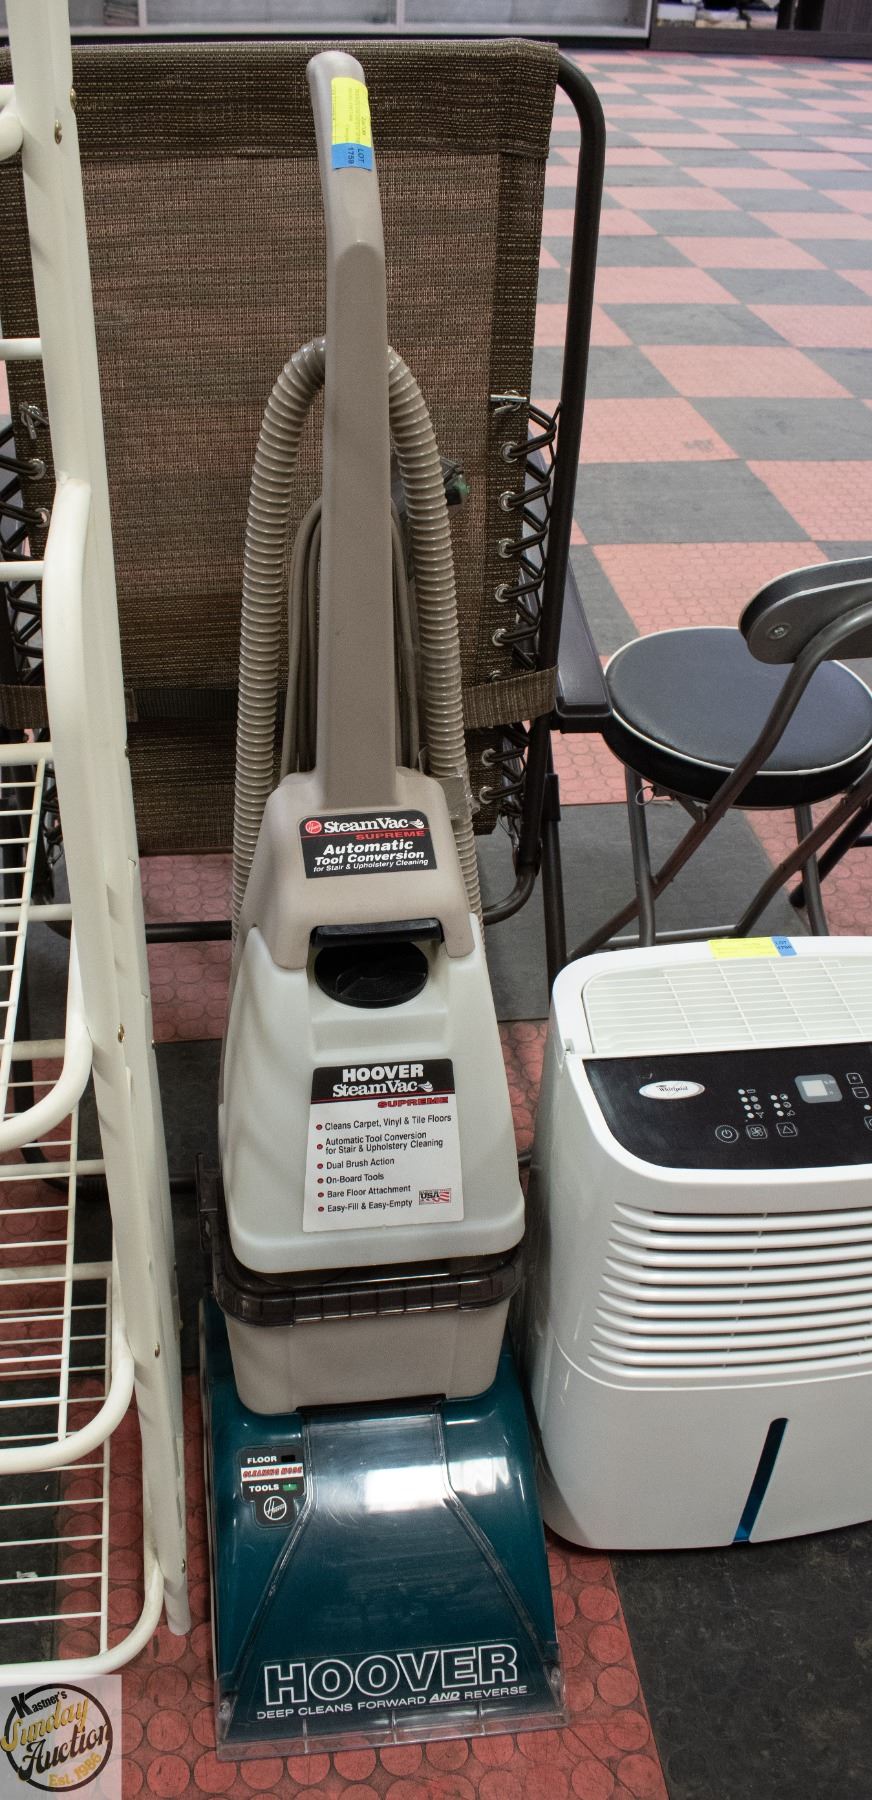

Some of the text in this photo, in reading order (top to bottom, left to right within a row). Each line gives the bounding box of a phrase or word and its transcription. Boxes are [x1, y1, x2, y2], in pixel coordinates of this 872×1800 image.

[357, 148, 366, 163] LOT
[324, 818, 408, 833] SteamVac
[355, 830, 425, 840] SUPREME
[322, 839, 414, 855] Automatic
[314, 850, 425, 866] Tool Conversion
[353, 860, 394, 869] Upholstery
[395, 858, 429, 866] Cleaning
[342, 1063, 424, 1083] HOOVER
[332, 1080, 418, 1098] SteamVac
[377, 1096, 449, 1108] SUPREME
[325, 1114, 452, 1131] Cleans Carpet, Vinyl & Tile Floors
[325, 1131, 427, 1146] Automatic Tool Conversion
[325, 1138, 444, 1155] for Stair & Upholstery Cleaning
[326, 1157, 395, 1170] Dual Brush Action
[326, 1172, 385, 1184] On-Board Tools
[327, 1185, 411, 1199] Bare Floor Attachment
[420, 1191, 439, 1199] USA
[327, 1199, 413, 1213] Easy-Fill & Easy-Empty
[247, 1455, 277, 1464] FLOOR
[243, 1466, 303, 1477] CLEANING MODE
[249, 1484, 279, 1493] TOOLS
[264, 1644, 518, 1706] HOOVER
[257, 1685, 527, 1720] DEEP CLEANS FORWARD AND REVERSE
